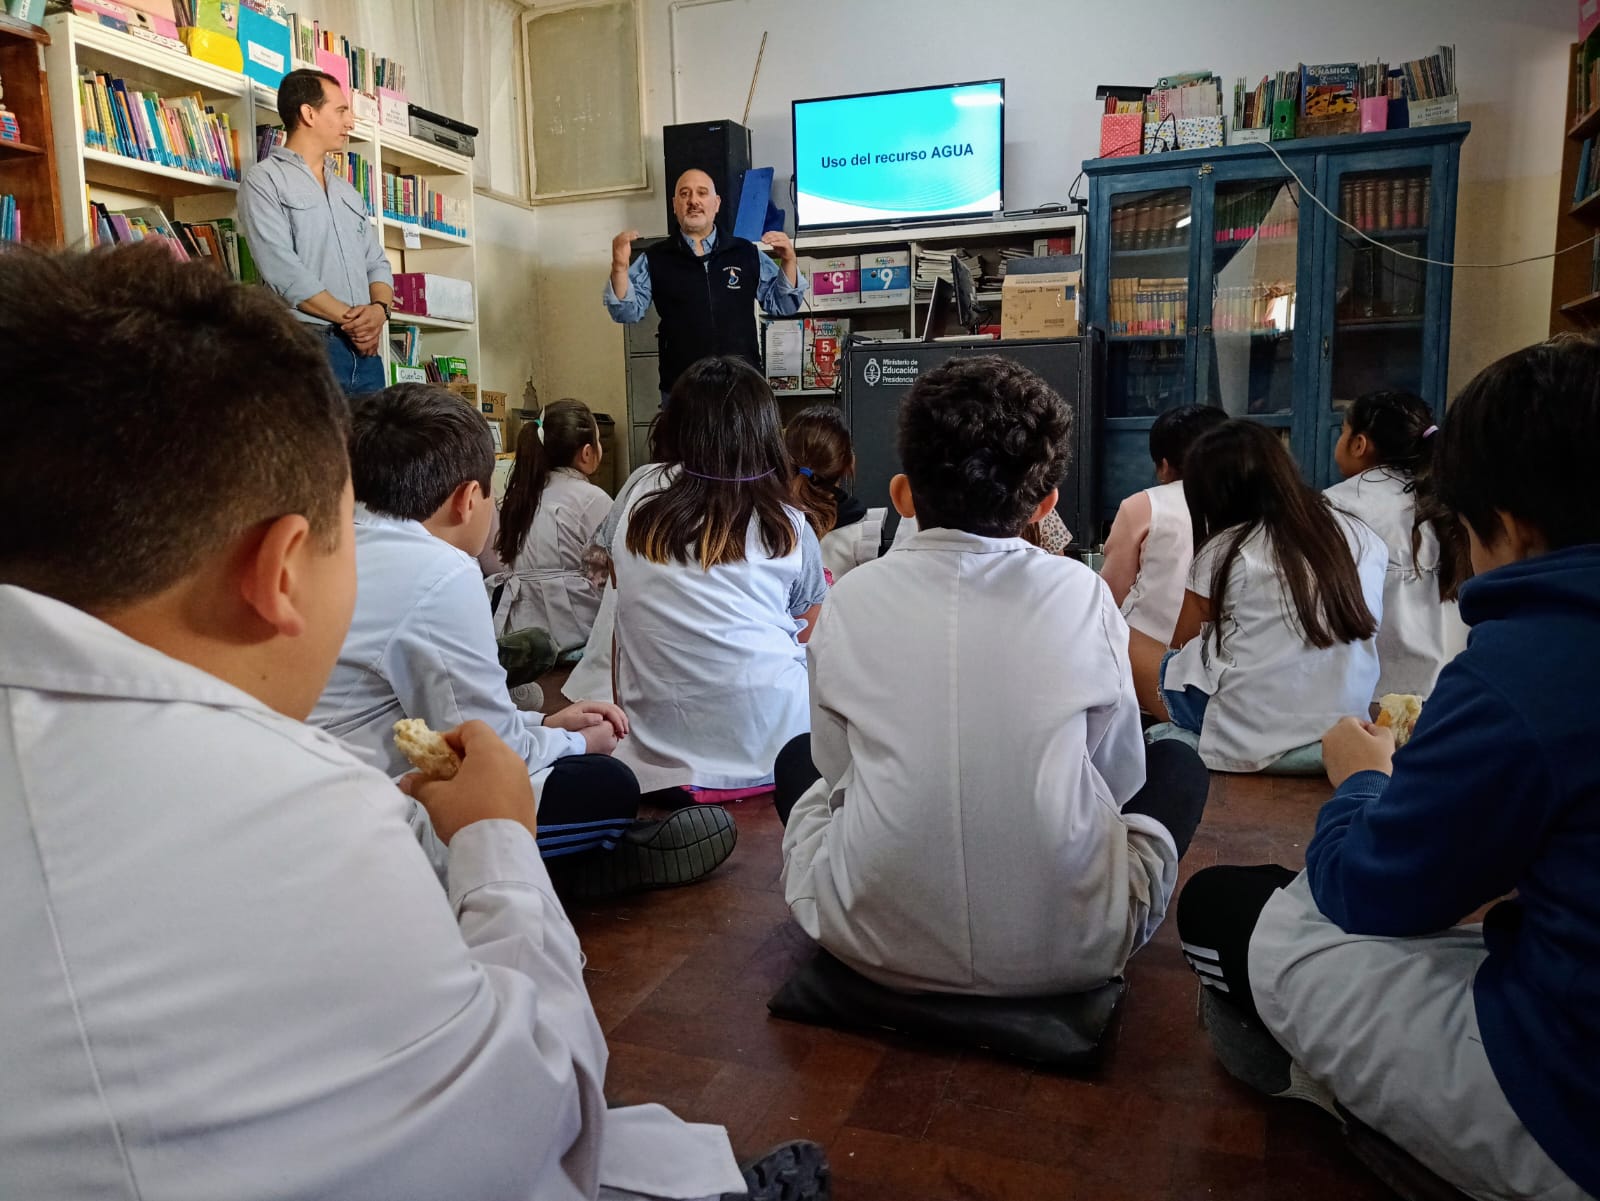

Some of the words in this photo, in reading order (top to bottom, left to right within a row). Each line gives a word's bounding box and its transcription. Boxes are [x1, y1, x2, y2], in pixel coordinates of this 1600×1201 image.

[821, 155, 847, 169] Uso
[851, 153, 871, 166] del
[875, 150, 927, 164] recurso
[931, 143, 974, 159] AGUA
[882, 358, 910, 366] Ministerio
[910, 358, 918, 366] de
[882, 366, 919, 374] Educación
[882, 375, 914, 383] Presidencia
